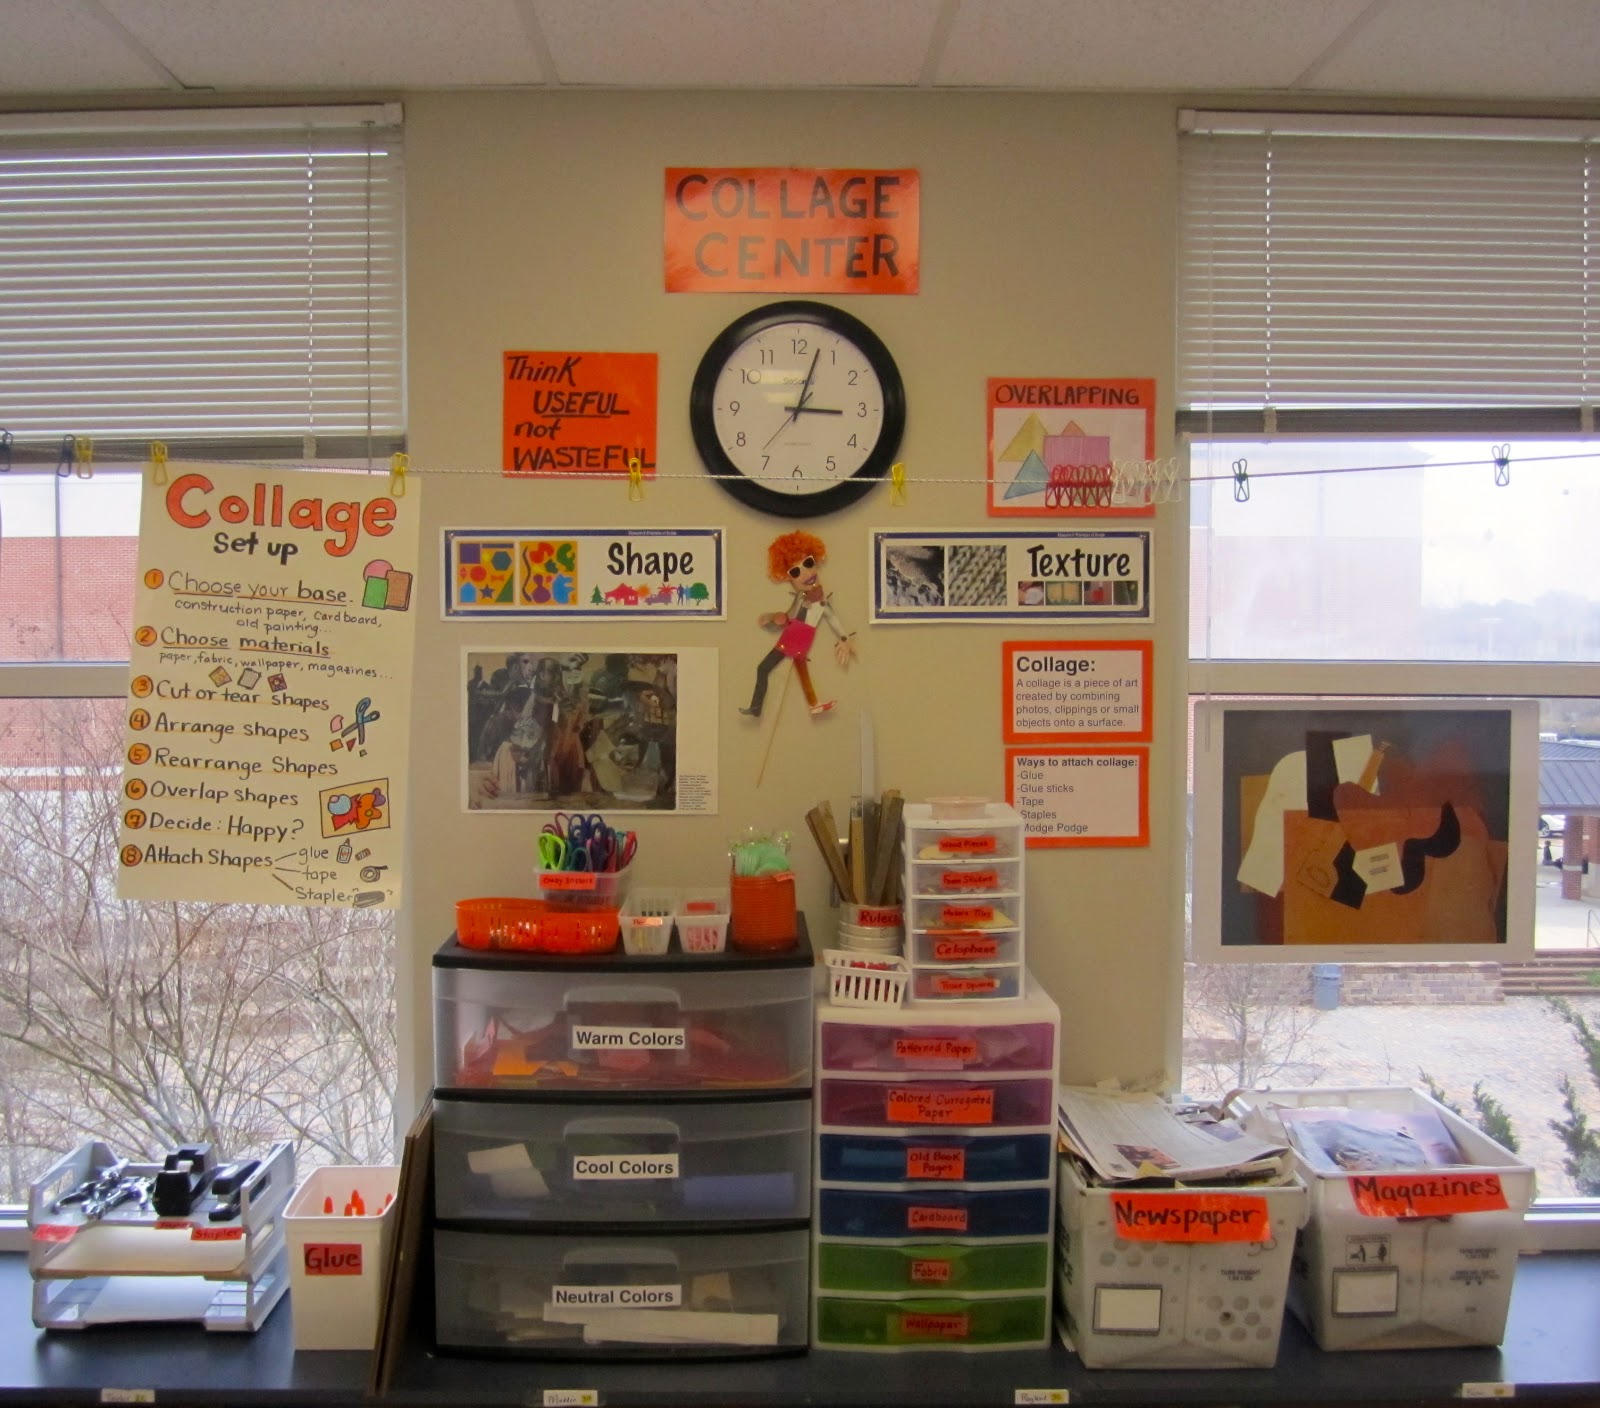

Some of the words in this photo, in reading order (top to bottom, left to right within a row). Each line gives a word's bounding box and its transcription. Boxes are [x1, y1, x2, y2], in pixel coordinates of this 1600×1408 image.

[675, 174, 900, 221] COLLAGE
[695, 232, 899, 279] CENTER
[791, 339, 808, 355] 12
[760, 350, 773, 365] 11
[831, 350, 835, 365] 1
[742, 369, 761, 384] 10
[848, 371, 857, 385] 2
[533, 390, 630, 415] USEFUL
[996, 384, 1139, 406] OVERLAPPING
[730, 401, 740, 416] 9
[857, 403, 867, 417] 3
[514, 418, 561, 440] not
[736, 432, 746, 446] 8
[847, 434, 857, 448] 4
[514, 445, 656, 471] WASTEFUL
[761, 456, 770, 470] 7
[826, 456, 836, 471] 5
[792, 465, 803, 479] 6
[166, 473, 396, 557] Collage
[214, 532, 259, 555] Set
[267, 541, 298, 565] up
[607, 541, 694, 582] Shape
[1027, 545, 1130, 577] Texture
[169, 570, 241, 595] Choose
[248, 582, 288, 600] your
[298, 580, 354, 603] base.
[175, 599, 261, 615] construction
[267, 607, 307, 622] paper,
[237, 618, 259, 629] old
[161, 627, 229, 647] Choose
[240, 635, 329, 656] materials
[241, 658, 304, 671] wallpaper,
[1016, 656, 1095, 676] Collage:
[1016, 679, 1023, 688] A
[1026, 679, 1060, 689] collage
[1064, 679, 1071, 688] is
[1075, 680, 1081, 688] a
[1084, 679, 1110, 689] piece
[1113, 679, 1122, 688] of
[1125, 679, 1138, 688] art
[157, 680, 191, 699] Cut
[196, 688, 217, 700] or
[224, 688, 261, 704] tear
[272, 691, 329, 712] shapes
[1016, 692, 1053, 701] created
[1055, 692, 1067, 703] by
[1070, 692, 1120, 702] combining
[1016, 705, 1051, 715] photos,
[1055, 705, 1097, 715] clippings
[1100, 706, 1110, 714] or
[1113, 704, 1139, 714] small
[155, 712, 234, 744] Arrange
[243, 718, 310, 743] shapes
[1016, 718, 1050, 729] objects
[1054, 719, 1075, 727] onto
[1087, 718, 1125, 727] surface.
[155, 748, 261, 780] Rearrange
[272, 756, 337, 778] Shapes
[1017, 758, 1045, 768] Ways
[1048, 758, 1059, 767] to
[1062, 758, 1093, 767] attach
[1097, 758, 1137, 769] collage:
[1017, 771, 1044, 780] -Glue
[150, 781, 228, 802] Overlap
[236, 789, 298, 809] shapes
[1017, 784, 1044, 793] -Glue
[1047, 784, 1074, 793] sticks
[1017, 797, 1044, 807] -Tape
[228, 815, 304, 843] Happy?
[1057, 823, 1088, 834] Podge
[145, 844, 203, 865] Attach
[209, 848, 273, 872] Shapes
[299, 846, 329, 865] glue
[302, 865, 337, 884] tape
[576, 1030, 623, 1046] Warm
[629, 1031, 684, 1047] Colors
[946, 1042, 973, 1058] Paper
[890, 1091, 931, 1103] Colored
[918, 1104, 953, 1121] Paper
[911, 1152, 929, 1161] Old
[576, 1160, 613, 1175] Cool
[619, 1159, 674, 1175] Colors
[1354, 1176, 1500, 1208] Magazines
[912, 1210, 966, 1223] Cardboard
[1114, 1200, 1262, 1234] Newspaper
[304, 1247, 361, 1268] Glue
[913, 1264, 948, 1279] Fabric
[556, 1290, 614, 1303] Neutral
[619, 1291, 673, 1303] Colors
